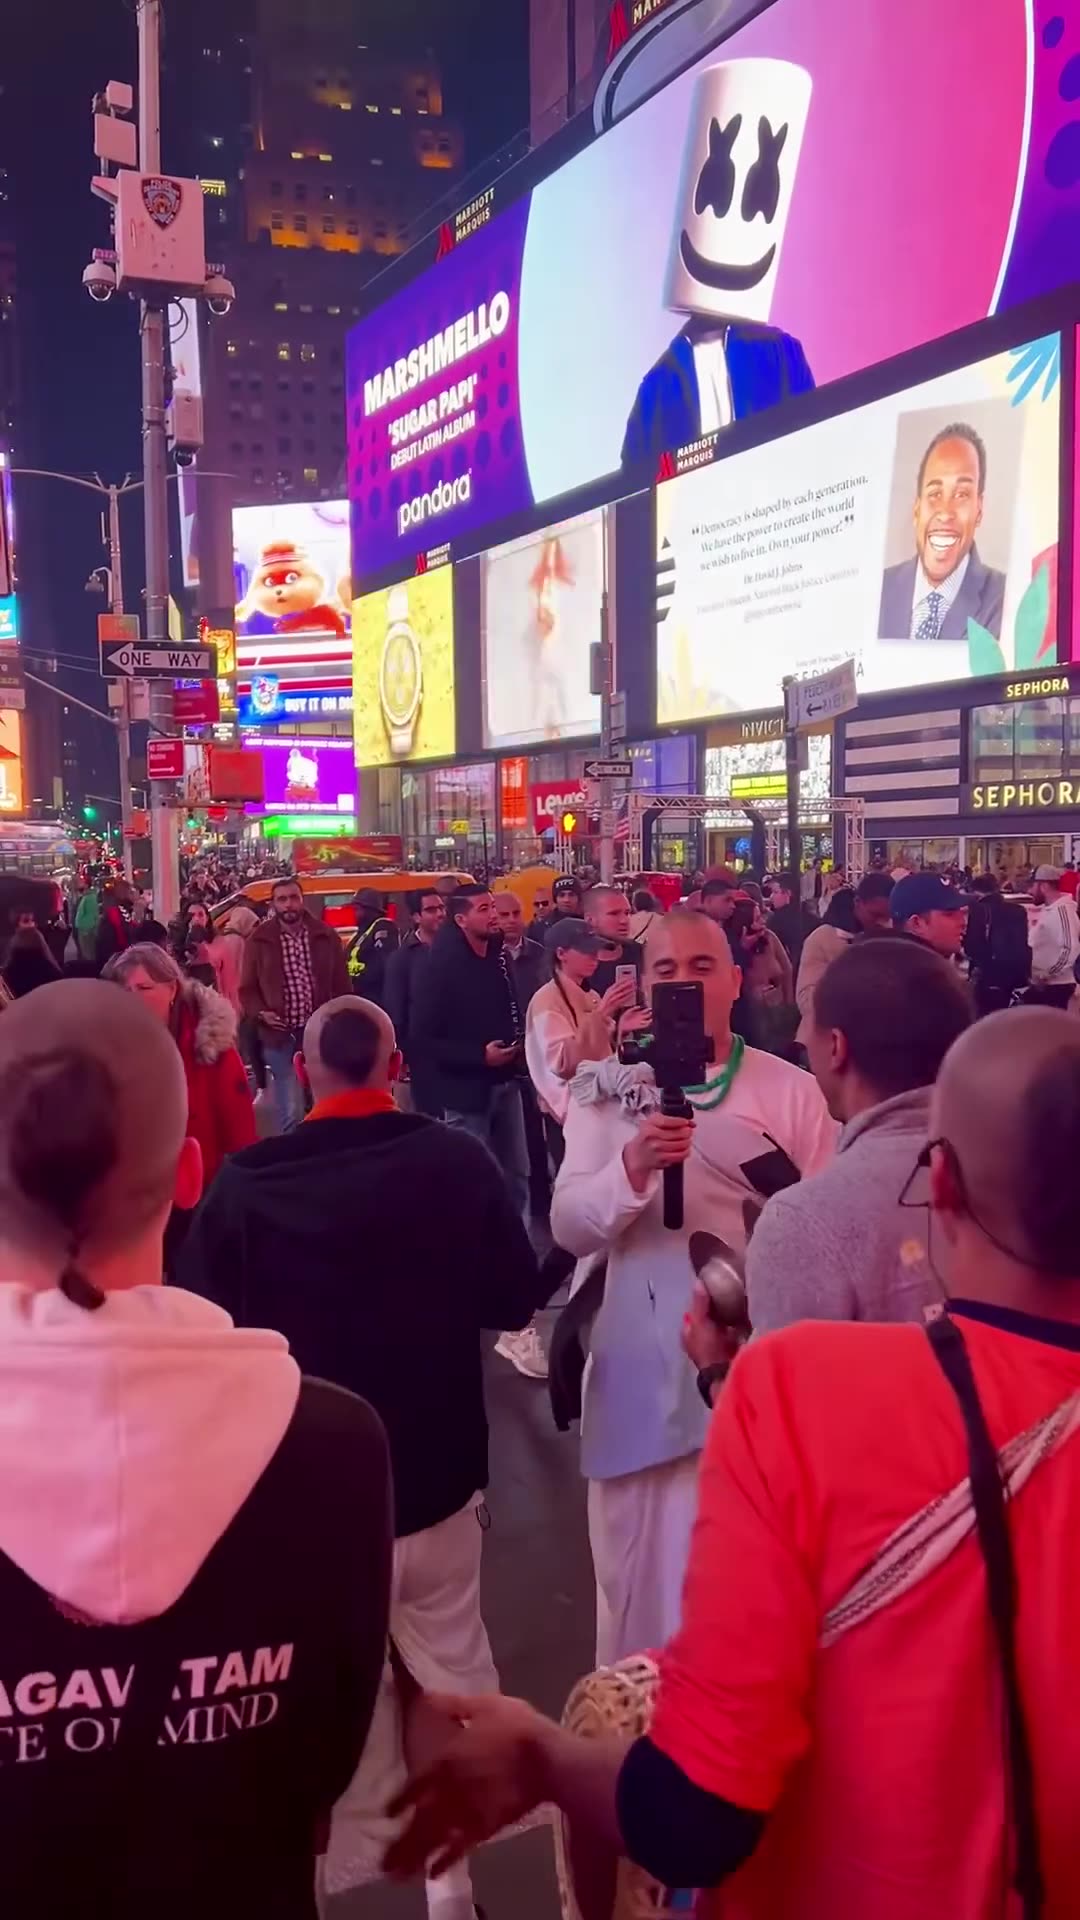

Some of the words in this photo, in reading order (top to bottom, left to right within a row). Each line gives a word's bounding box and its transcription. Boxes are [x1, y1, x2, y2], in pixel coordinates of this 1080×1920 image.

[456, 187, 495, 227] MARRIOTT
[456, 207, 490, 242] MARQUIS
[363, 291, 510, 417] MARSHMELLO
[391, 443, 417, 471] DEBUT
[417, 430, 442, 458] LATIN
[442, 410, 476, 448] ALBUM
[676, 434, 719, 458] MARRIOTT
[676, 449, 714, 471] MARQUIS
[397, 472, 471, 537] pandora
[752, 498, 781, 518] shaped
[794, 489, 814, 505] each
[714, 538, 732, 549] have
[732, 532, 746, 543] the
[746, 524, 772, 542] power
[773, 520, 782, 531] to
[783, 513, 810, 528] create
[811, 507, 827, 520] the
[827, 496, 855, 513] world
[711, 553, 730, 567] wish
[730, 552, 740, 563] to
[768, 537, 789, 552] Own
[119, 652, 152, 666] ONE
[168, 653, 202, 667] WAY
[1007, 677, 1070, 698] SEPHORA
[308, 697, 320, 711] IT
[321, 696, 337, 711] ON
[741, 718, 785, 737] INVICT
